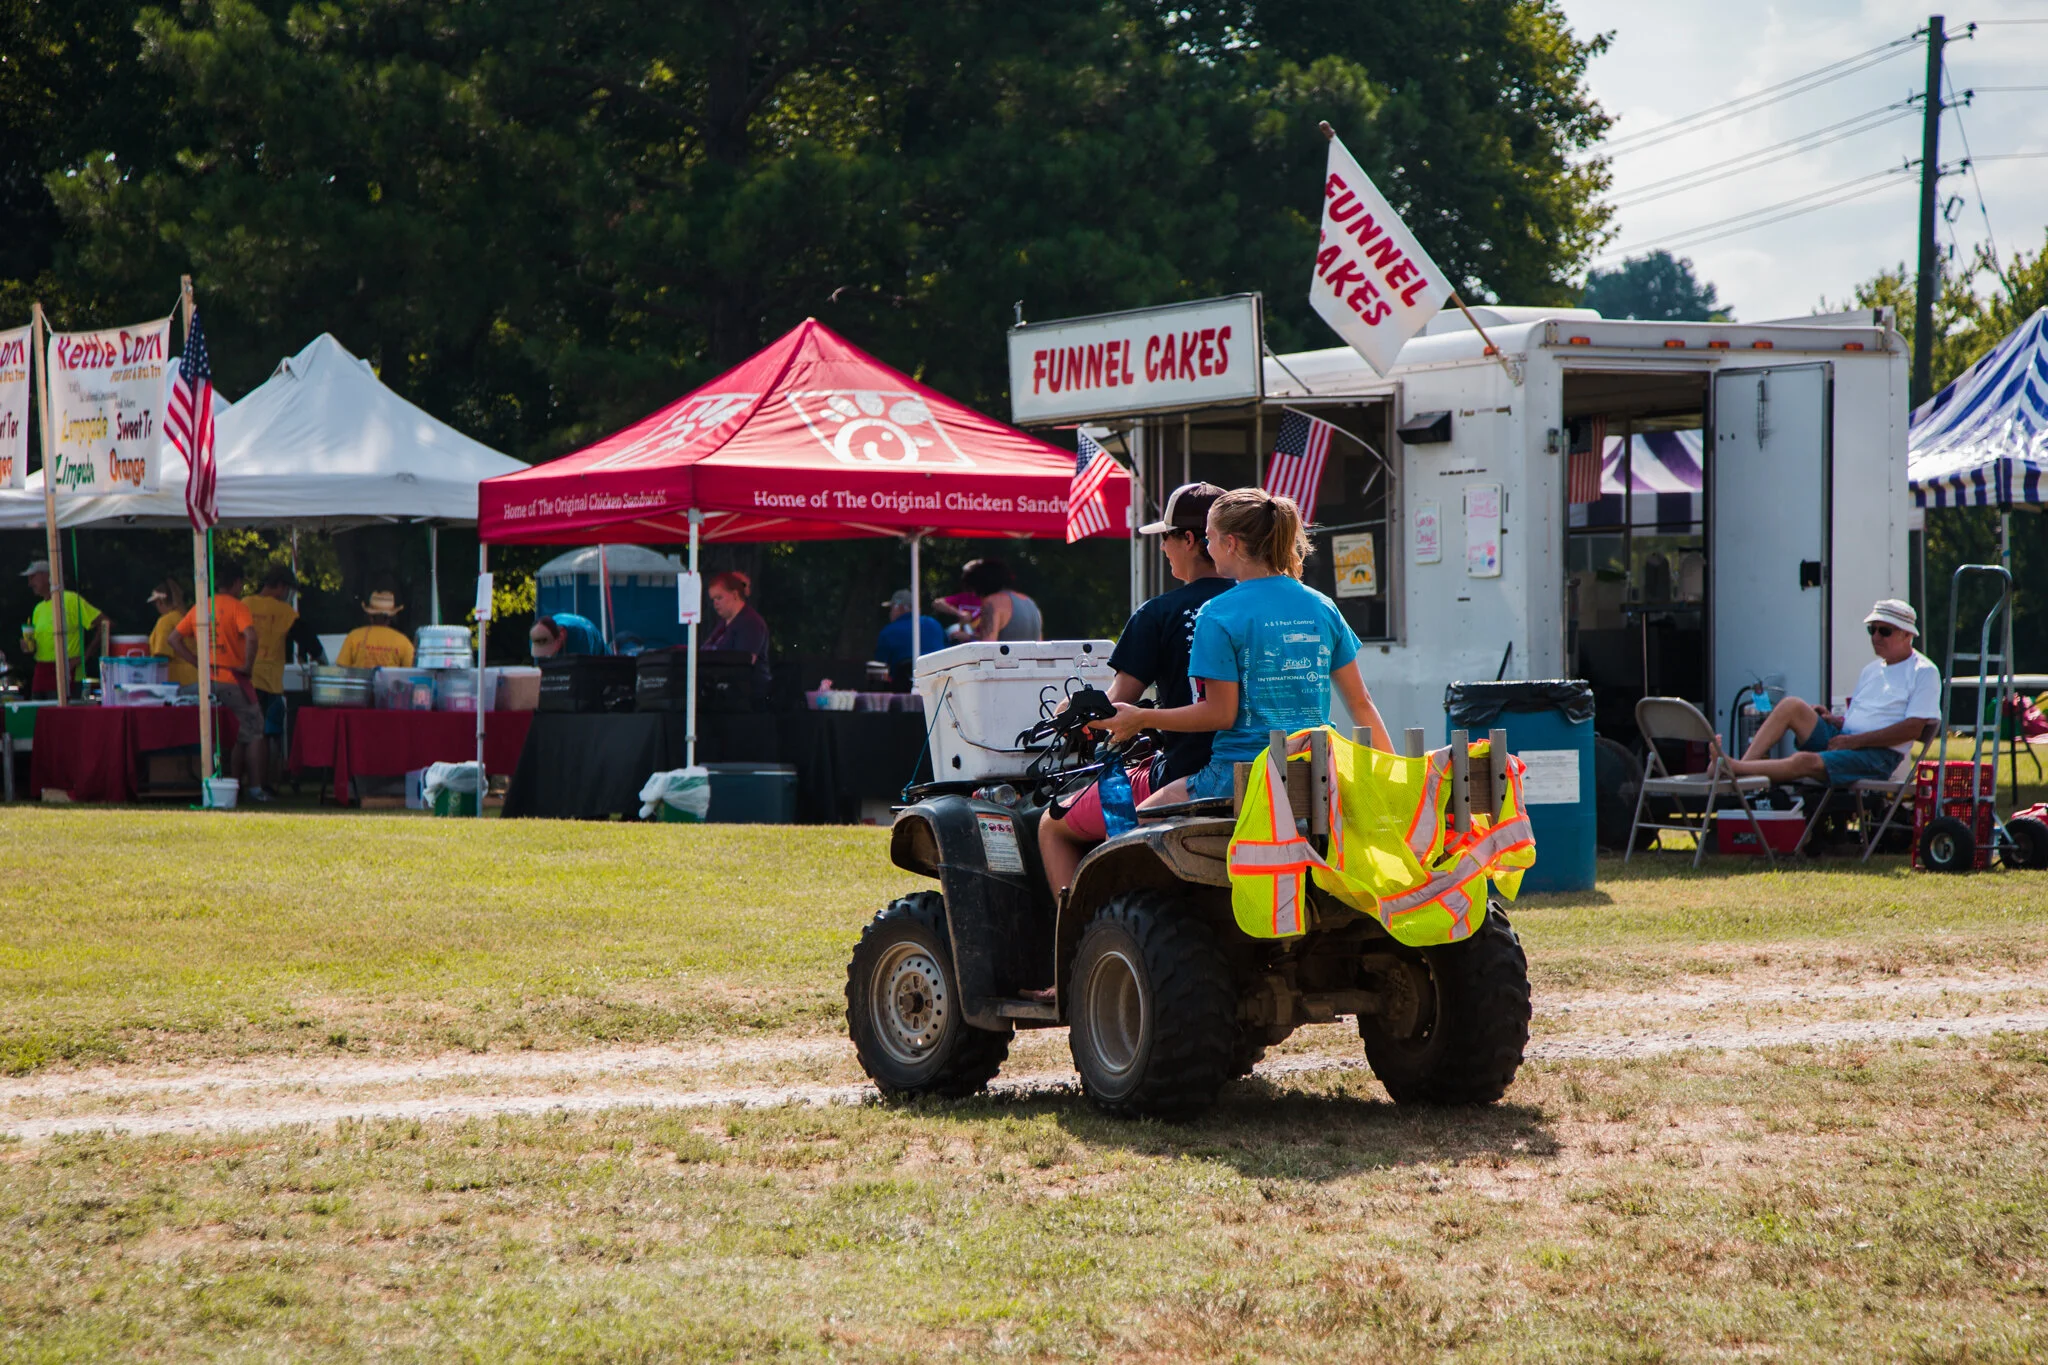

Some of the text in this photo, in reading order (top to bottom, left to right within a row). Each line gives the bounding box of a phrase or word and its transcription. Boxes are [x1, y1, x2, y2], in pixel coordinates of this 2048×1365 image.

[1325, 173, 1428, 308] FUNNEL
[1316, 229, 1392, 327] AKES
[0, 338, 25, 369] orn
[57, 330, 162, 371] Kettle Corn
[1033, 326, 1232, 396] FUNNEL CAKES
[117, 411, 142, 441] Sweet
[504, 503, 527, 520] Home
[528, 499, 538, 517] of
[538, 497, 554, 517] The
[555, 492, 588, 517] Original
[588, 491, 622, 512] Chicken
[754, 490, 1070, 514] Home of The Original Chicken Sandw
